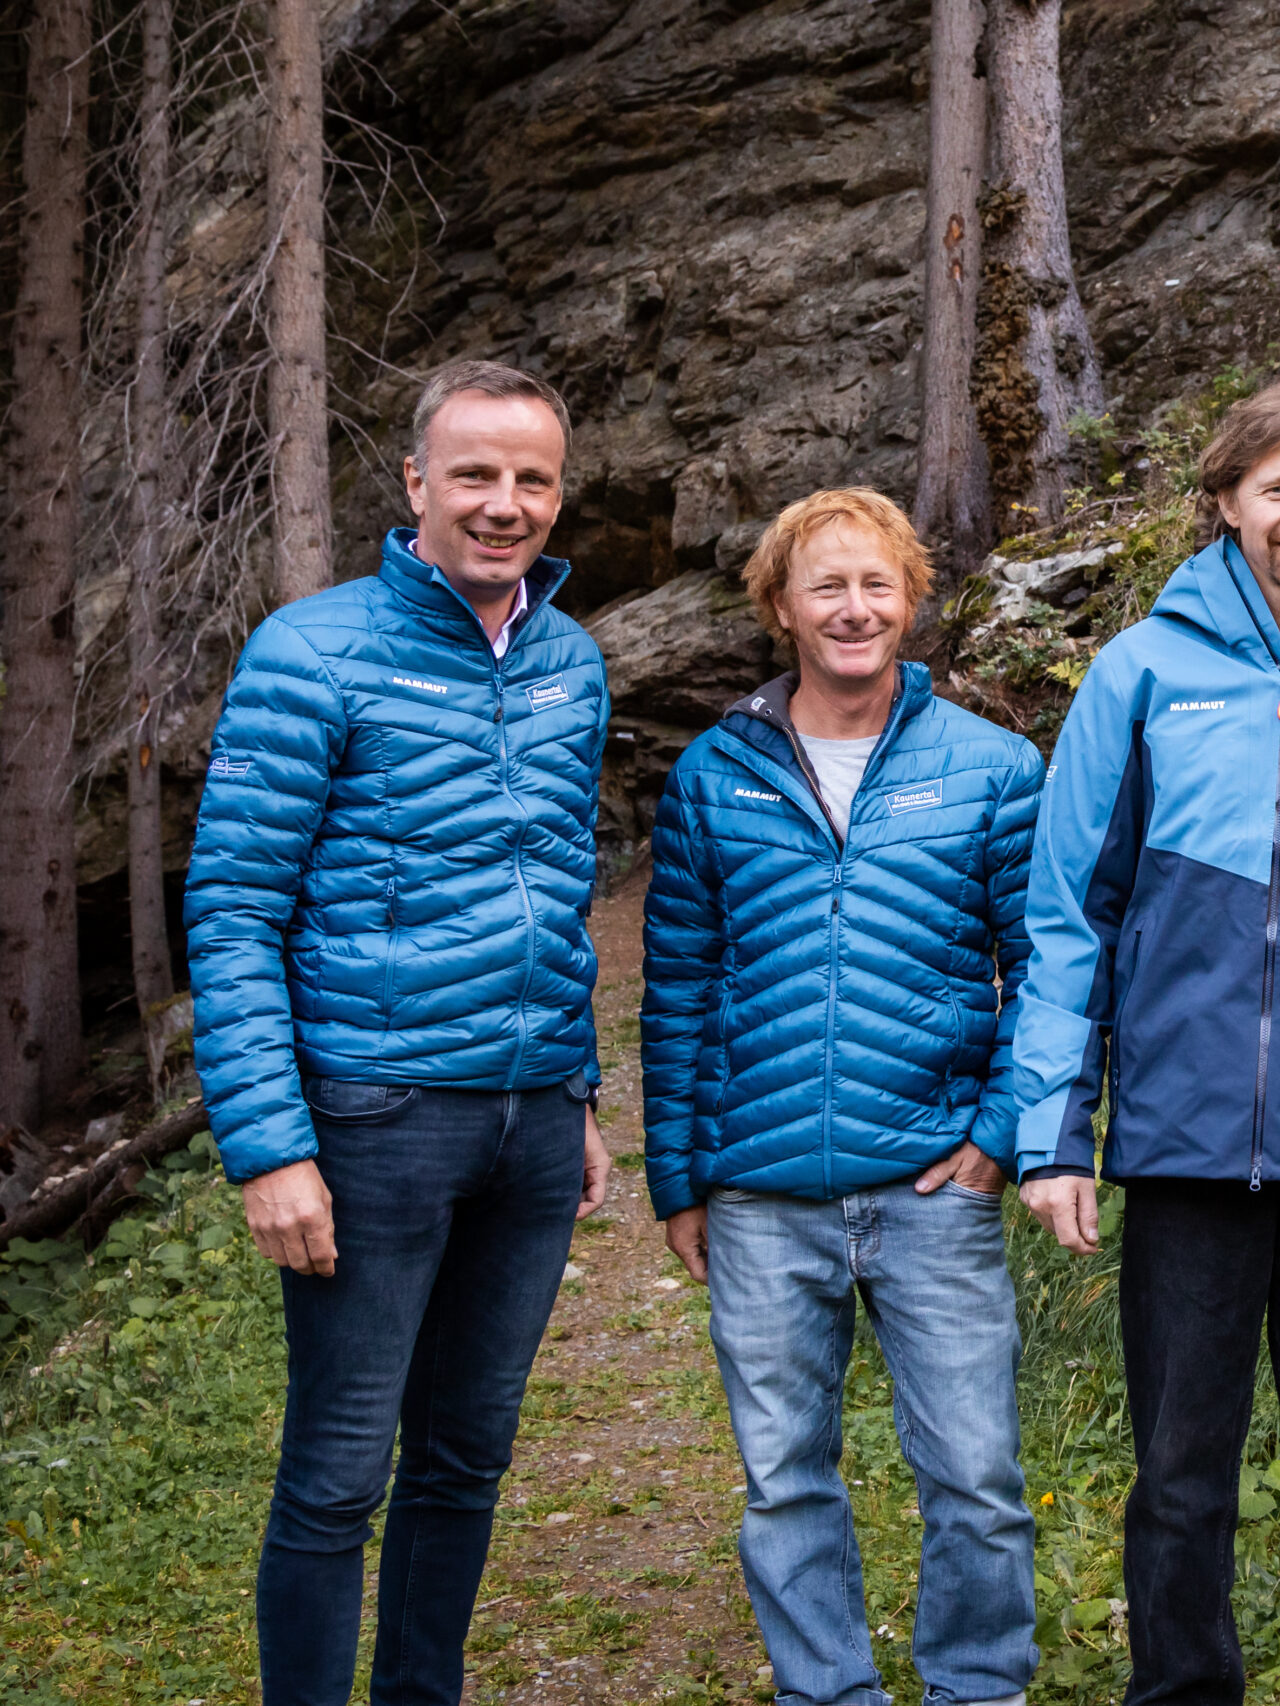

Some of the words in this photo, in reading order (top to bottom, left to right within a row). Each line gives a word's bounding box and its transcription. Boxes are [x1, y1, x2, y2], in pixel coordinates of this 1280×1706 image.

[393, 676, 448, 694] MAMMUT
[1169, 700, 1226, 711] MAMMUT
[734, 788, 782, 803] MAMMUT
[894, 789, 936, 804] Kaunertal
